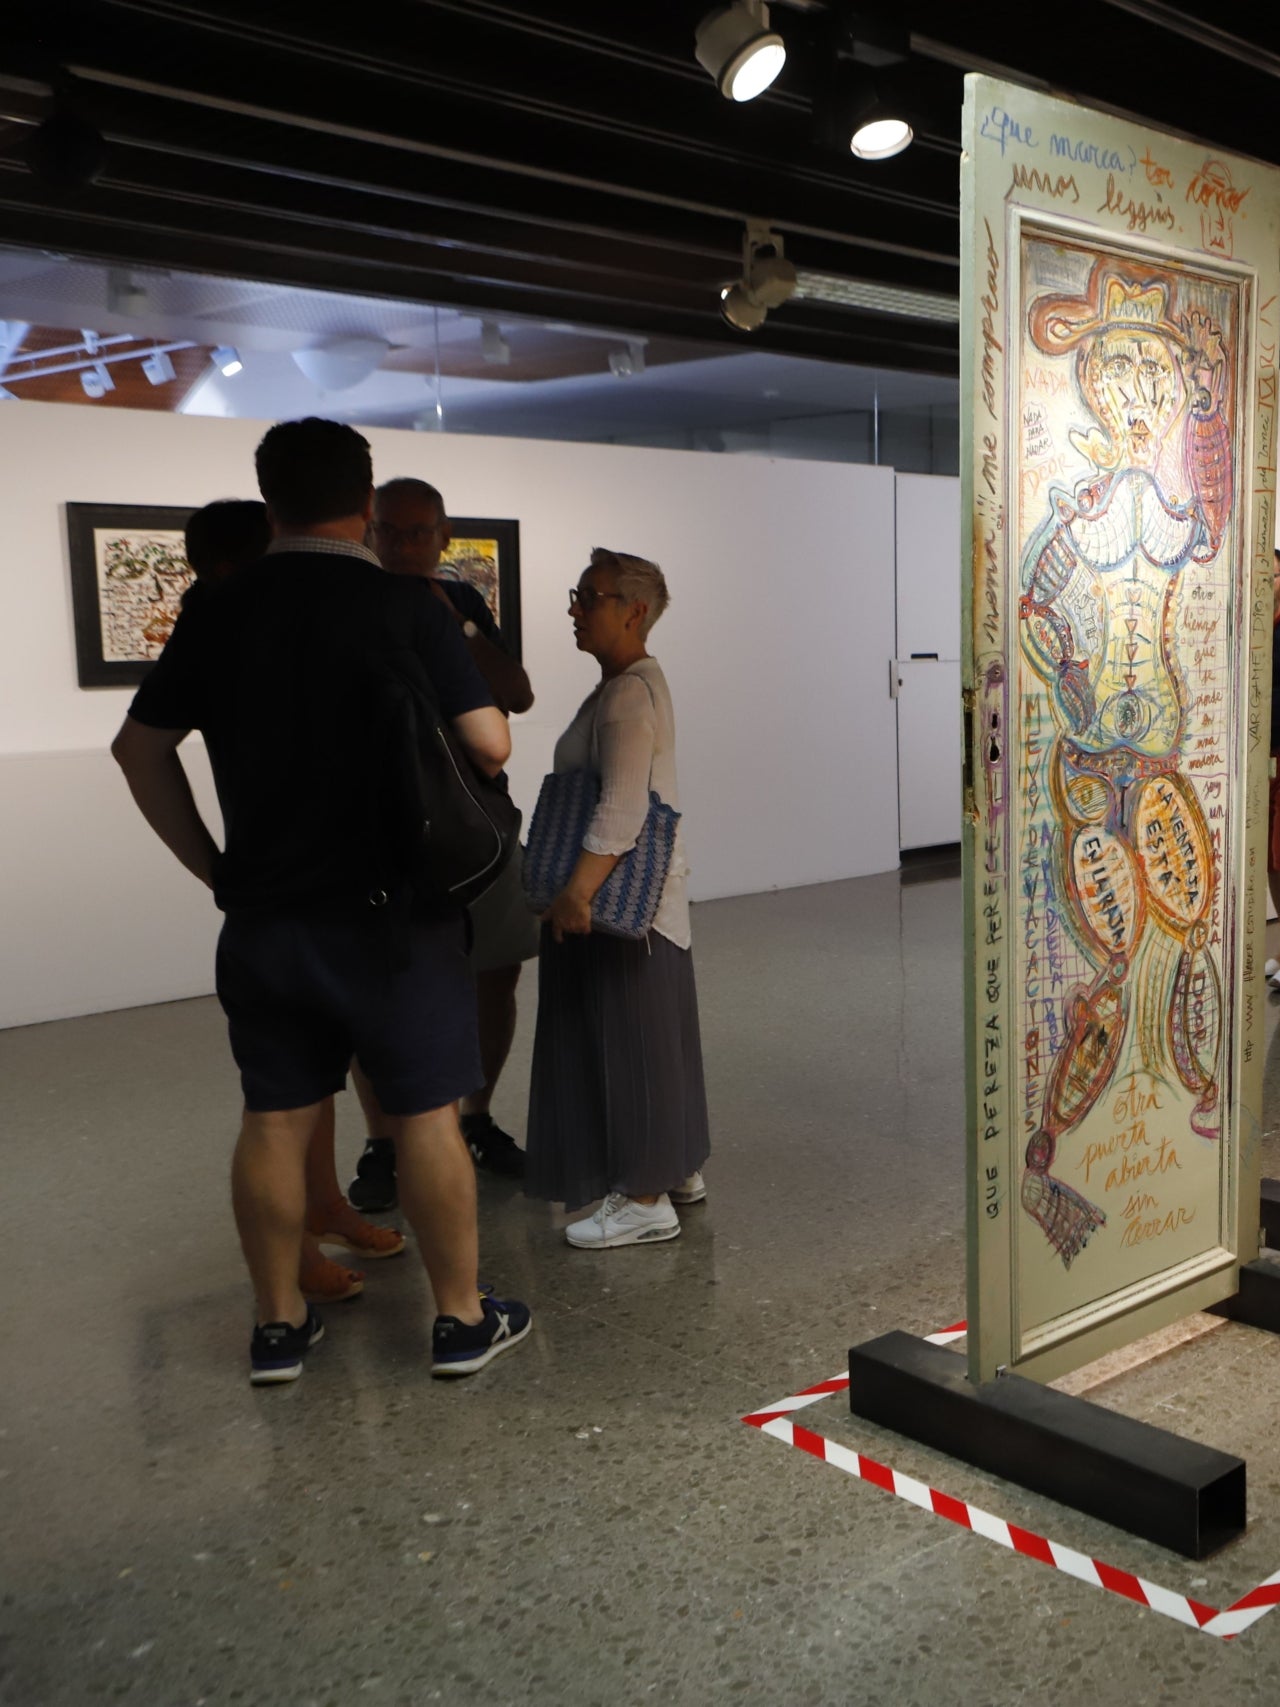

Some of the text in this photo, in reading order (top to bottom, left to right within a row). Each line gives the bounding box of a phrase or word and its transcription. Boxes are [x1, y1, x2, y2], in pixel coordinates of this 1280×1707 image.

[980, 431, 998, 496] me
[985, 955, 1001, 1003] QUE
[984, 1013, 1006, 1141] PEREZA
[1112, 1066, 1165, 1124] otra
[1075, 1120, 1151, 1184] puerta
[1104, 1137, 1183, 1192] abierta
[984, 1165, 1001, 1221] QUE
[1119, 1189, 1160, 1219] sin
